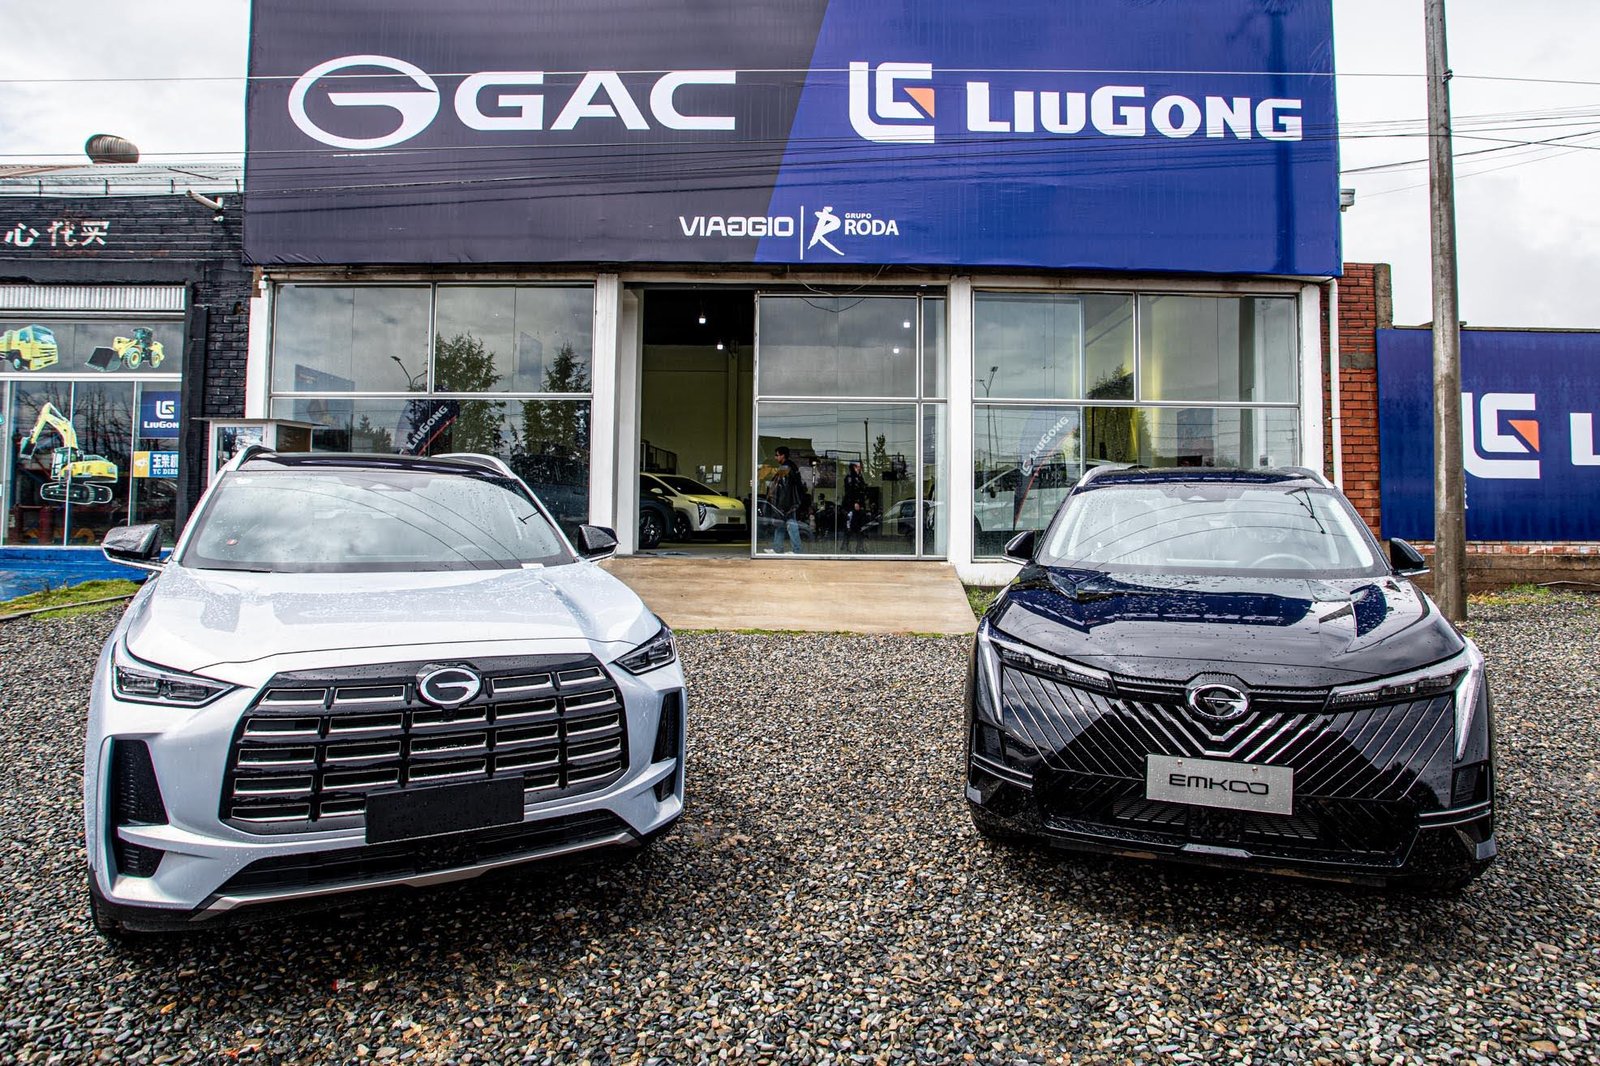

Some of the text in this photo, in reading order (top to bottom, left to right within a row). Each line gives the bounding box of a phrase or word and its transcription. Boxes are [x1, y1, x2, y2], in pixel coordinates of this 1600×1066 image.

[454, 70, 737, 131] GAC
[966, 81, 1304, 142] LIUGONG
[678, 216, 794, 237] VIAGGIO
[844, 219, 900, 237] RODA
[406, 405, 449, 450] LIUGONG
